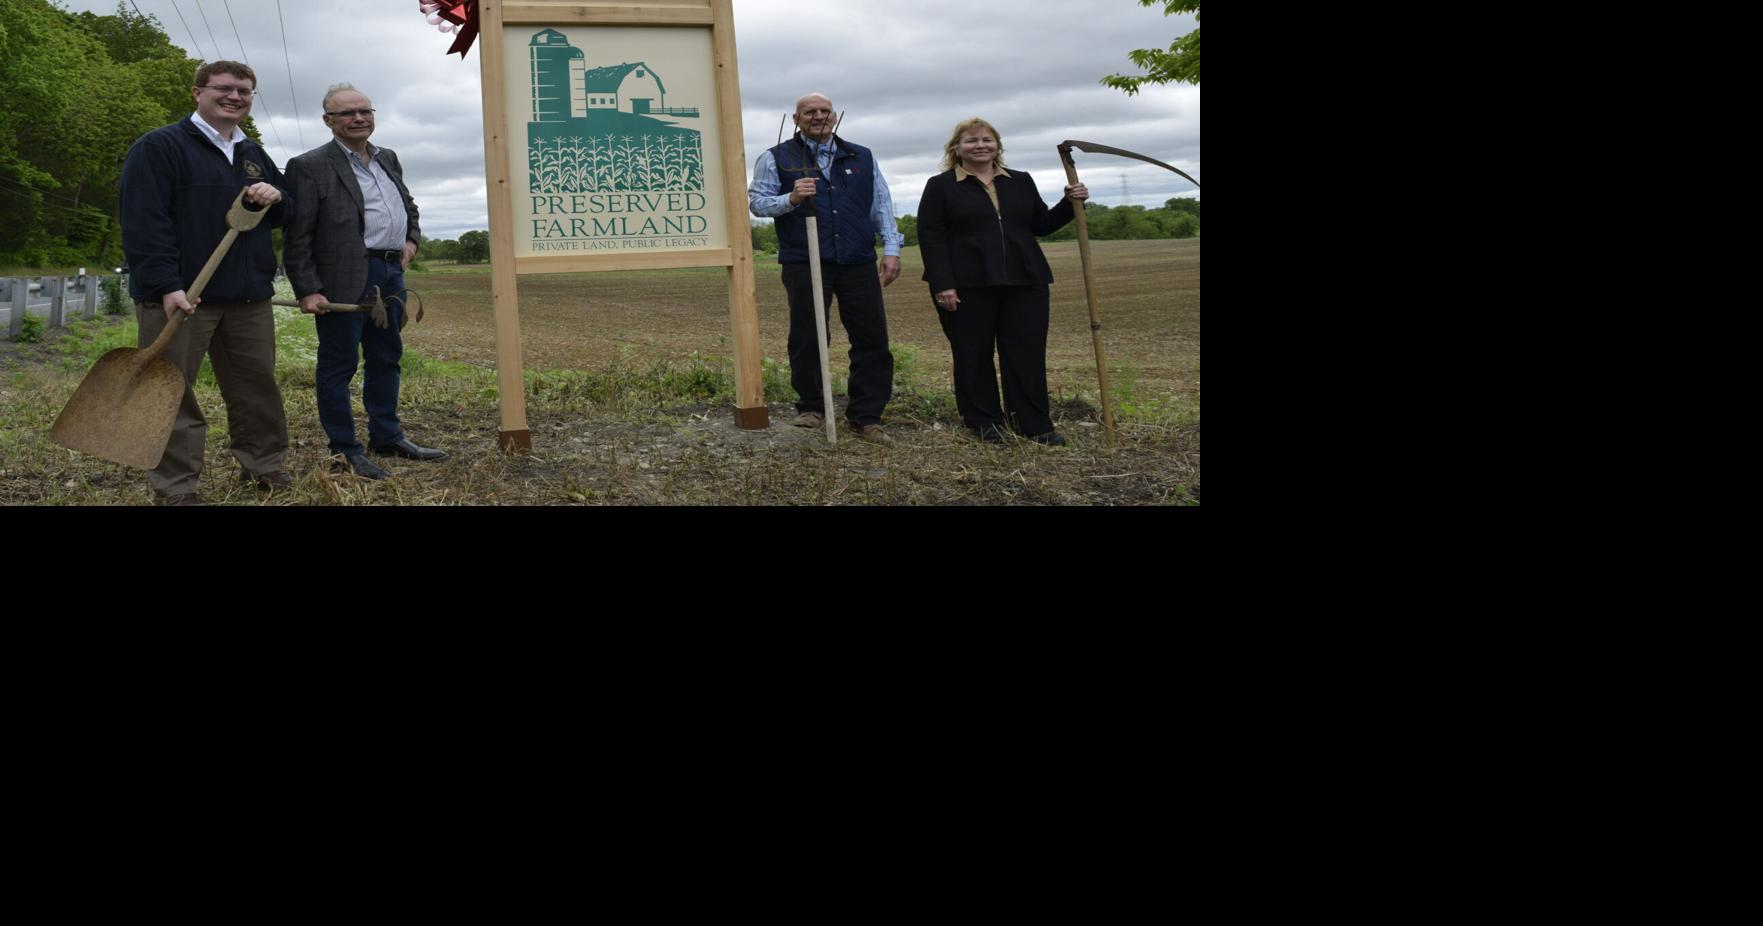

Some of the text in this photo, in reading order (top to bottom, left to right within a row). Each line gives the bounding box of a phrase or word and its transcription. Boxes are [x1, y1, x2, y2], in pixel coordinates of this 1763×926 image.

[531, 193, 706, 214] PRESERVED
[531, 216, 707, 237] FARMLAND
[532, 241, 578, 251] PRIVATE
[622, 239, 661, 248] PUBLIC
[665, 238, 708, 247] LEGACY
